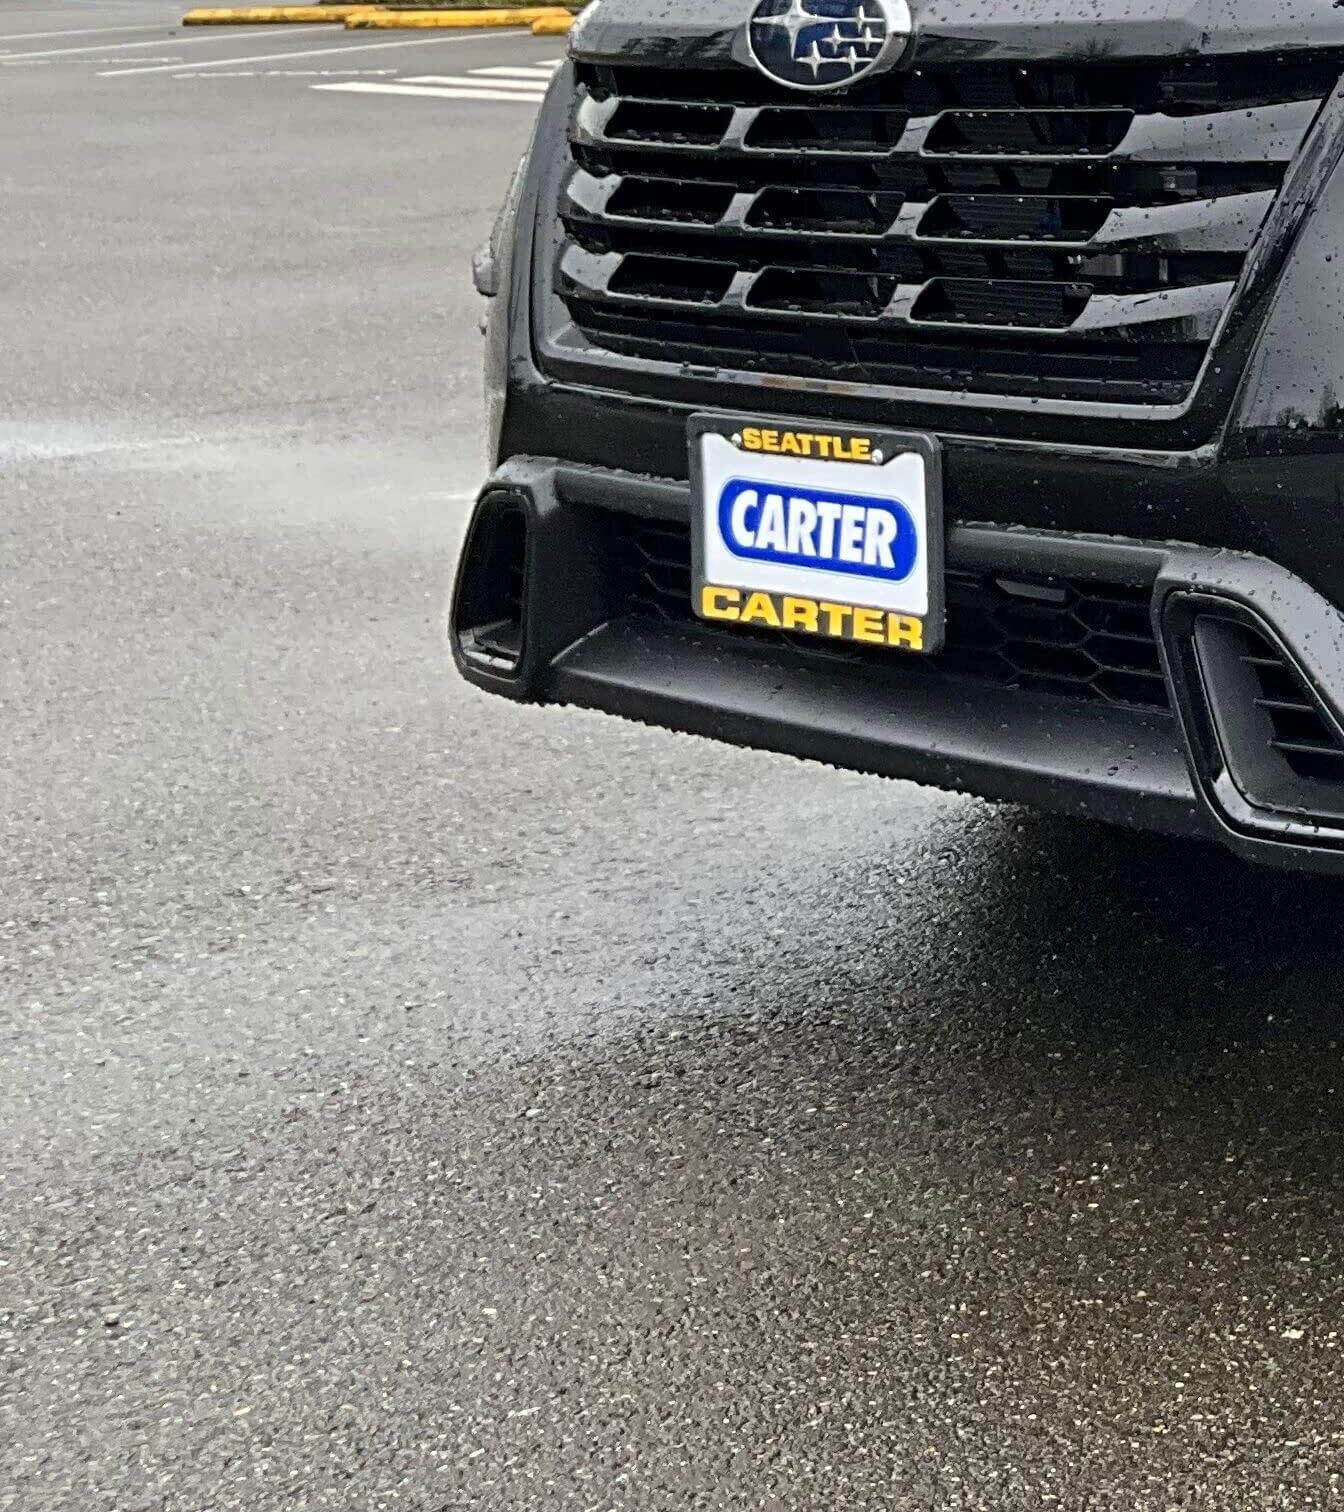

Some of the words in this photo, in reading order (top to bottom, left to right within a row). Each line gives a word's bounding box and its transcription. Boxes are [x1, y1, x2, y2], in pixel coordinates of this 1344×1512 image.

[742, 428, 873, 462] SEATTLE
[731, 490, 898, 569] CARTER
[702, 586, 924, 651] CARTER
